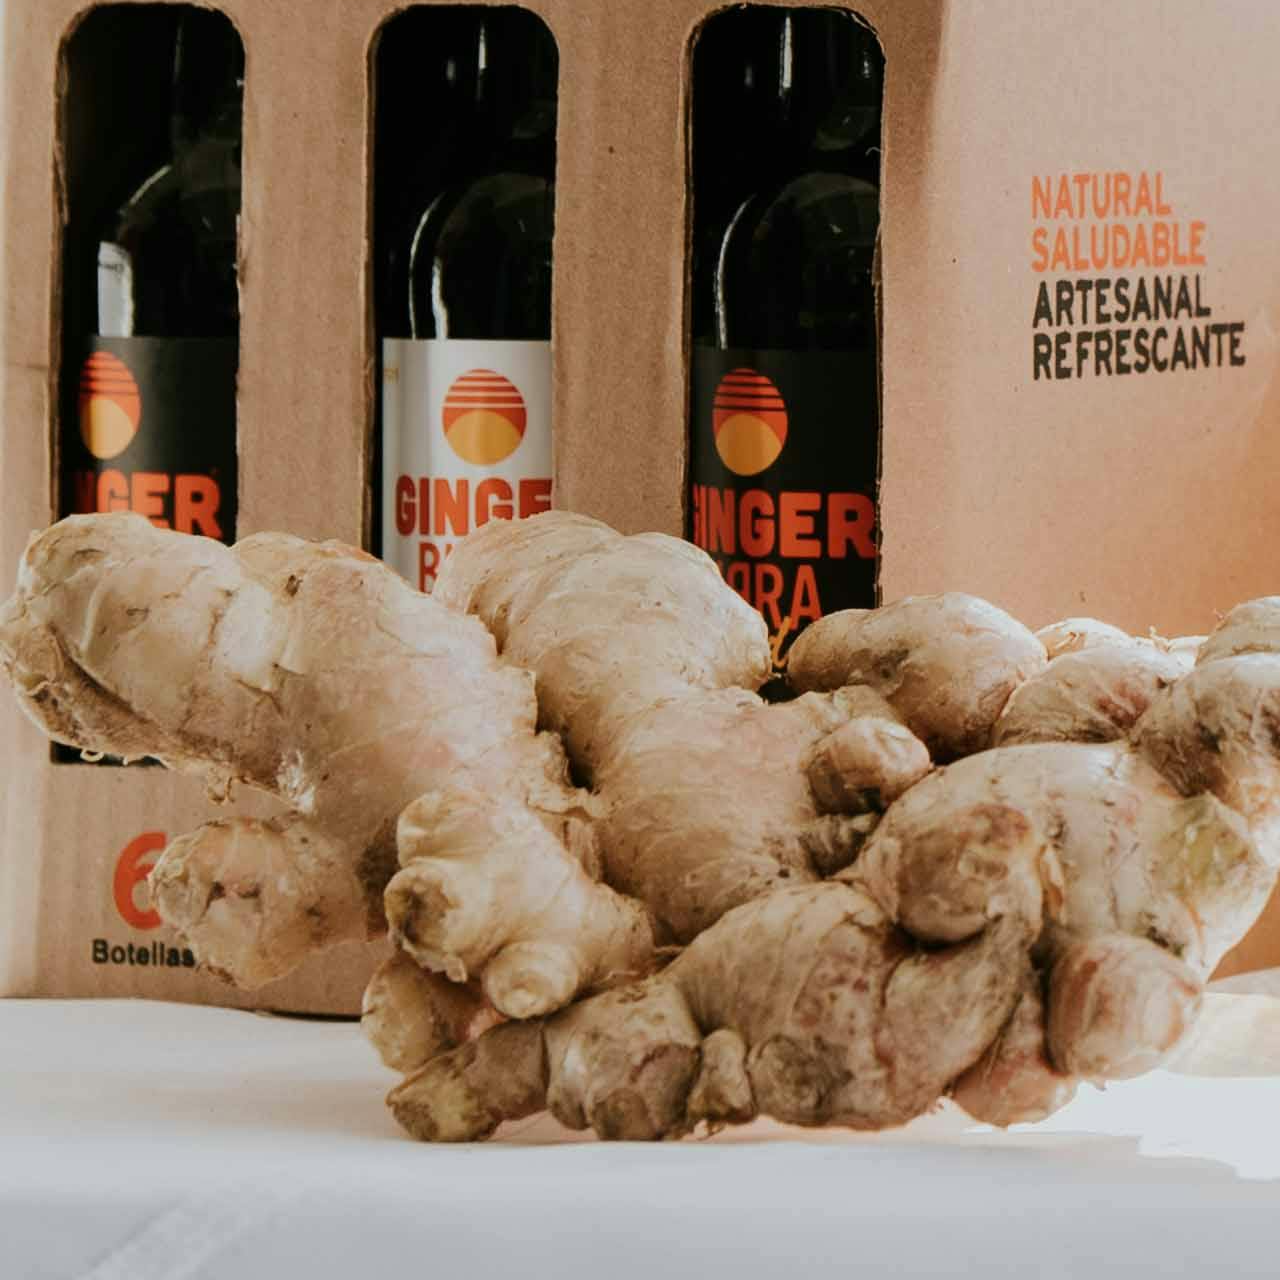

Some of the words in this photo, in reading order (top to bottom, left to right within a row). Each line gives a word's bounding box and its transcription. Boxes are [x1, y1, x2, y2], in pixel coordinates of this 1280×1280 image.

[1031, 172, 1173, 219] NATURAL
[1031, 221, 1206, 272] SALUDABLE
[1032, 273, 1212, 328] ARTESANAL
[1033, 322, 1246, 381] REFRESCANTE
[92, 938, 196, 968] Botellas
